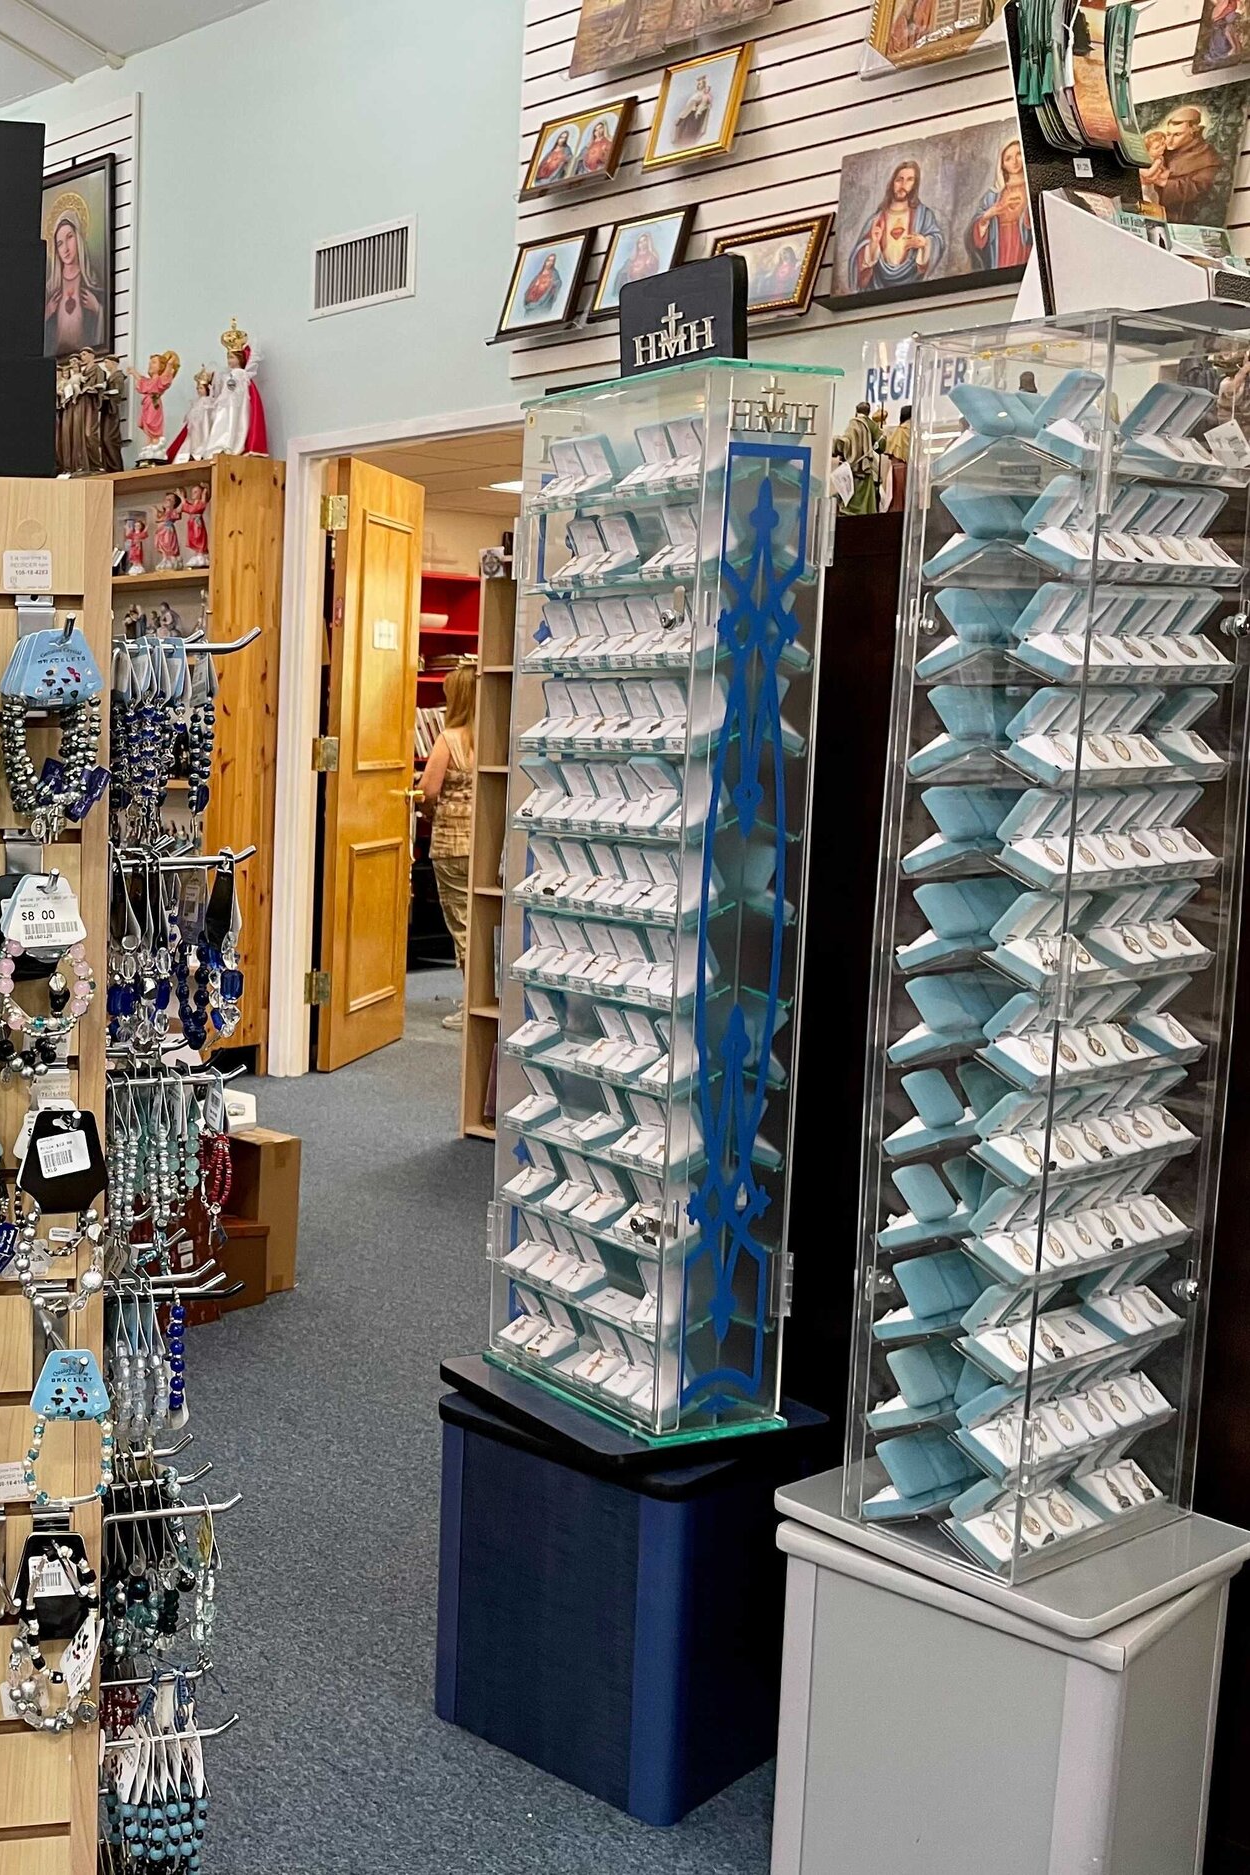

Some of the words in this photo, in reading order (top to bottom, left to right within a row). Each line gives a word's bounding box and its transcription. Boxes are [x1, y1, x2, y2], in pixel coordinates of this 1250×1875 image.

[633, 316, 716, 367] HMH
[856, 357, 967, 403] REGITER
[729, 400, 819, 435] HMH
[37, 656, 86, 664] BRACELETS
[52, 1368, 71, 1377] Quality
